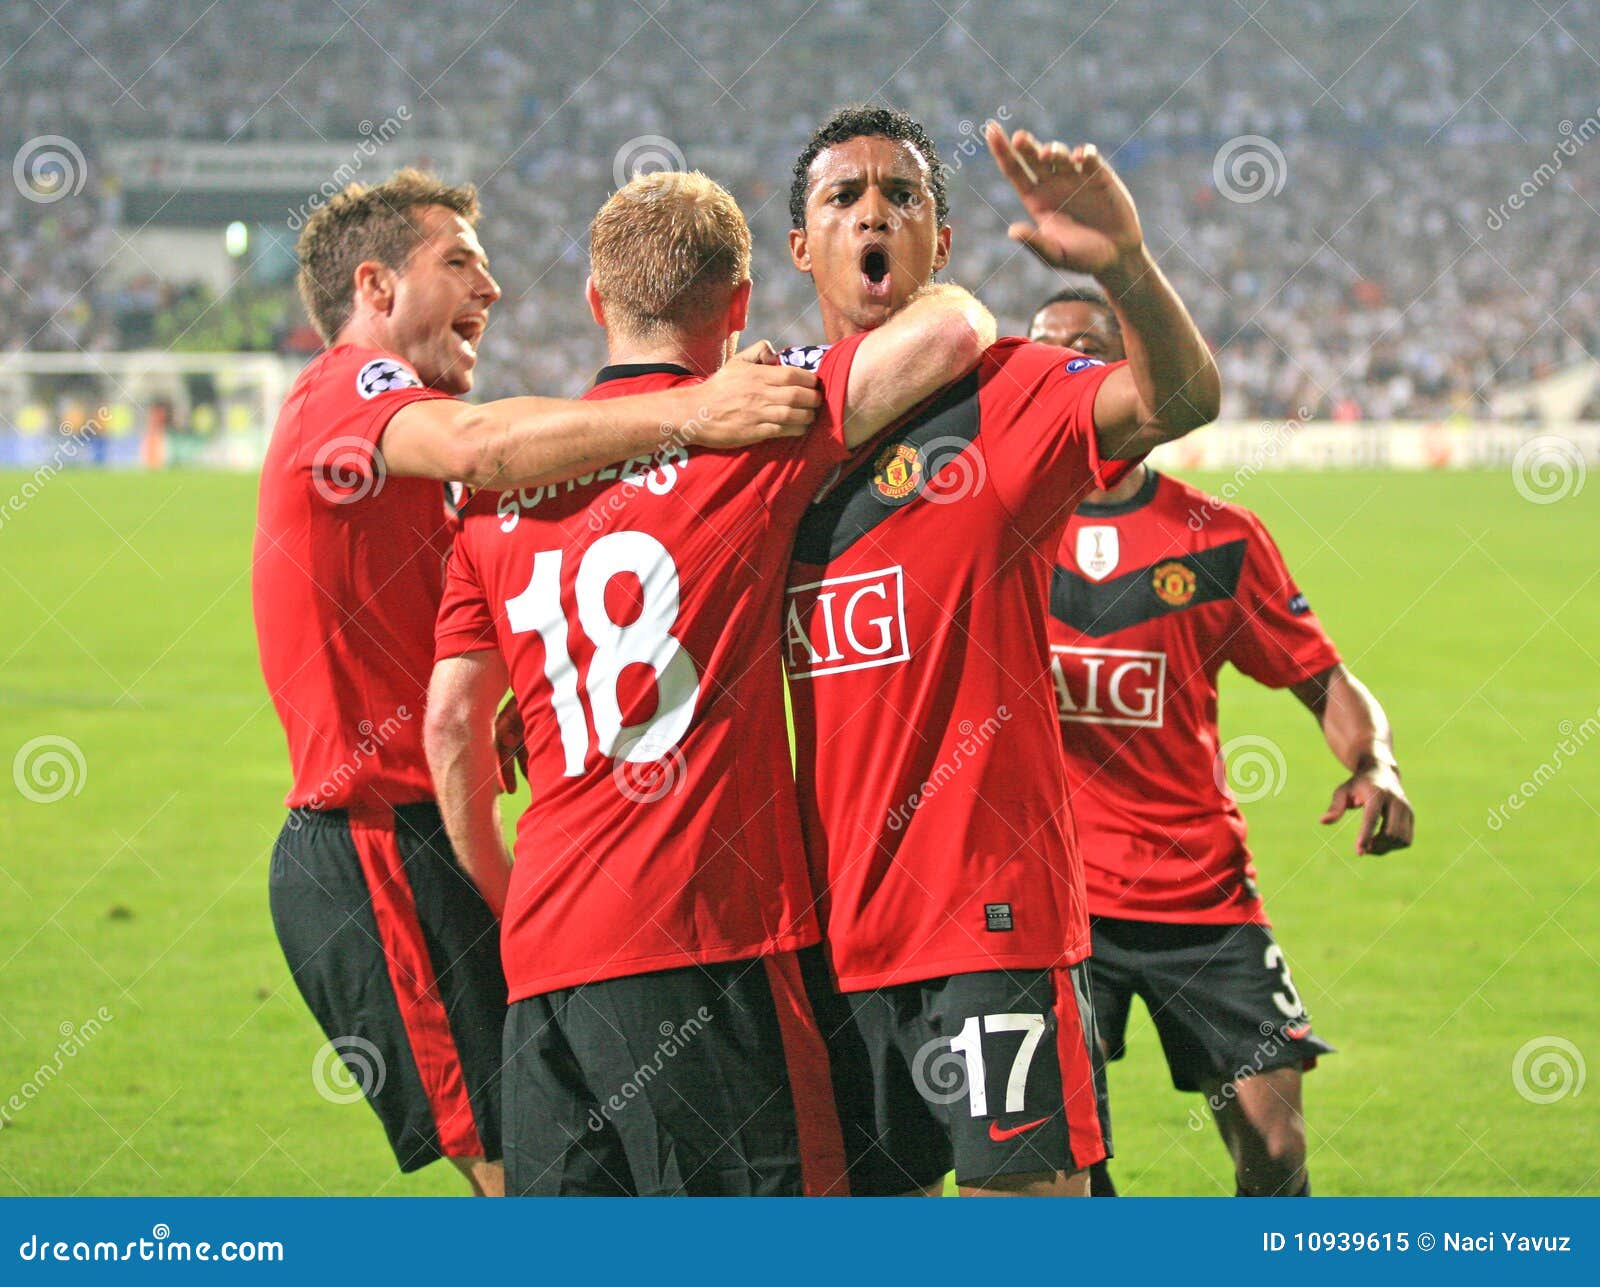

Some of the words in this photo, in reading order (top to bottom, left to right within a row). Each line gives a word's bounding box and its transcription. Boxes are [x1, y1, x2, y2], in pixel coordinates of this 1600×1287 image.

[886, 481, 914, 495] UNITED
[505, 531, 699, 777] 18
[787, 582, 893, 667] AIG
[1265, 945, 1303, 1019] 3
[949, 1013, 1046, 1117] 17
